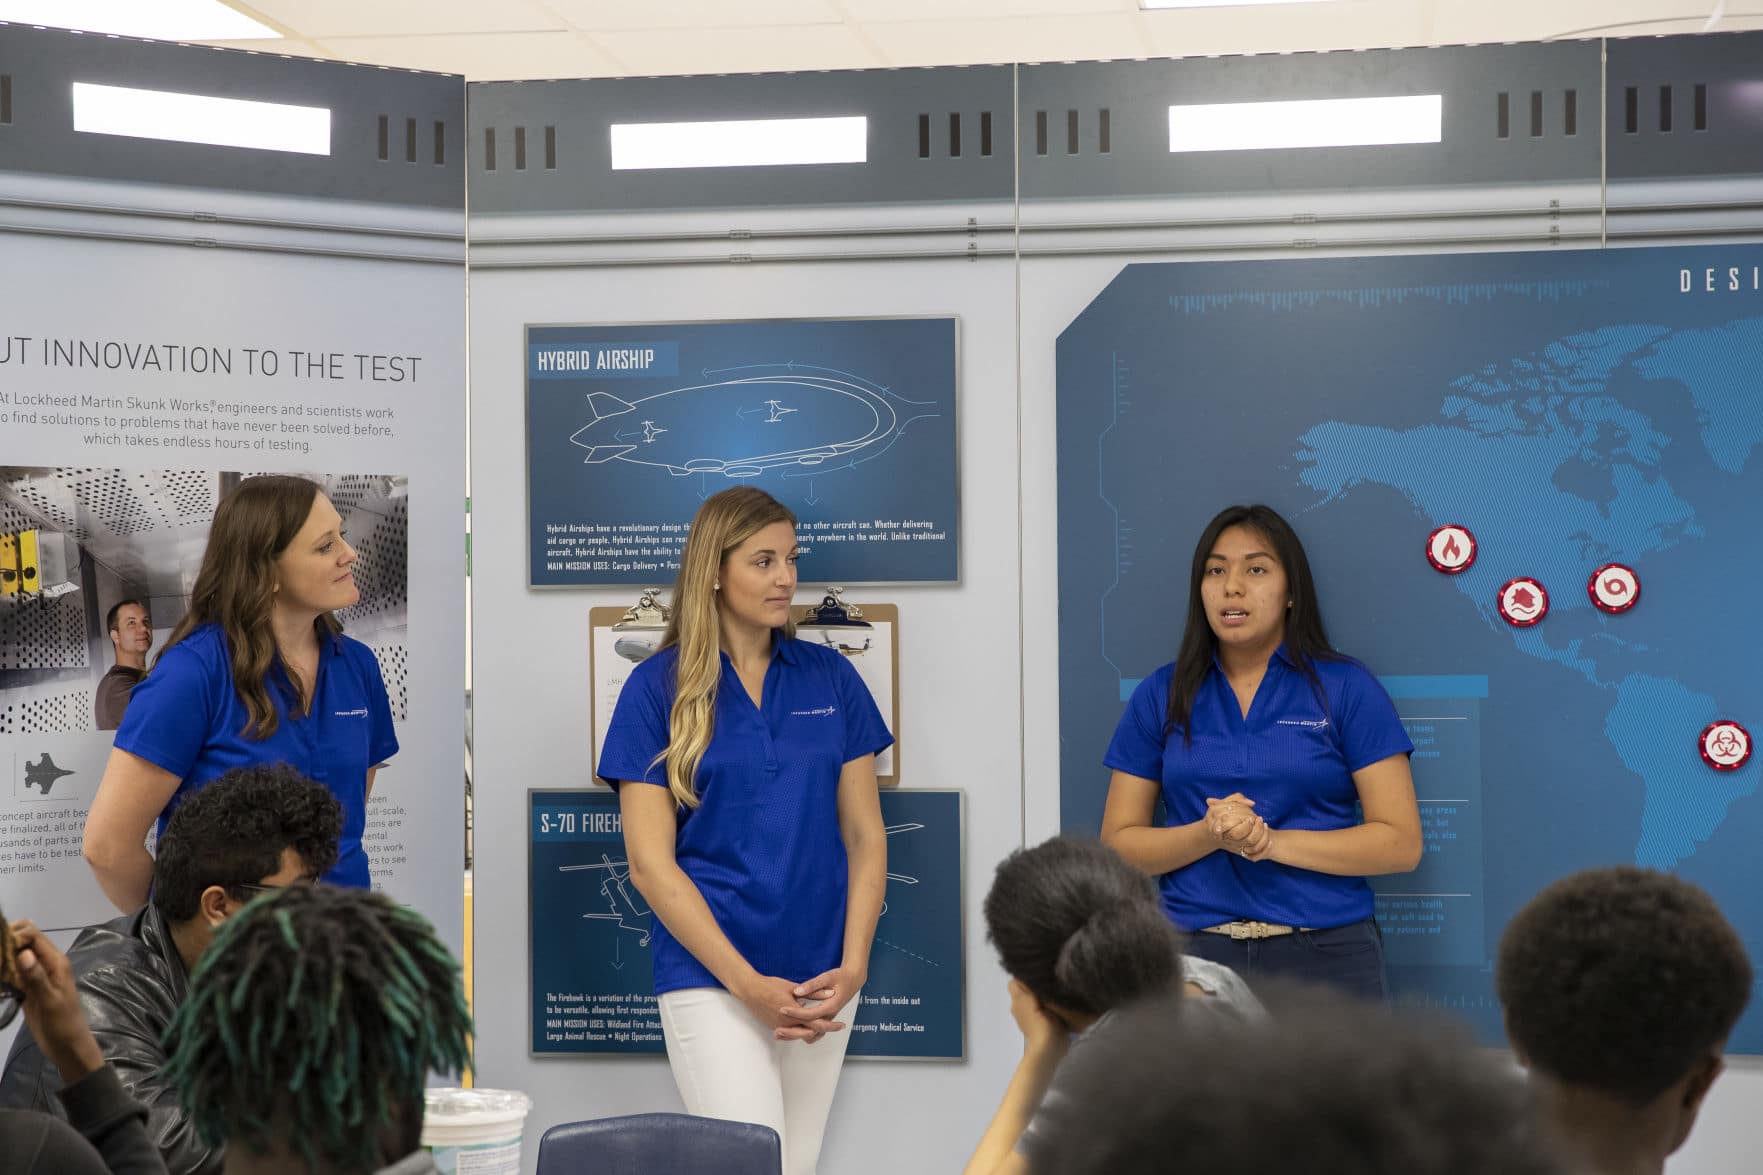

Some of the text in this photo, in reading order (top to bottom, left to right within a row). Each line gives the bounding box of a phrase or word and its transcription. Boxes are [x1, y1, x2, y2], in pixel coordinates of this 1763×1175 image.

[1680, 266, 1759, 292] DESI
[0, 337, 422, 382] UT INNOVATION TO THE TEST
[538, 349, 654, 371] HYBRID AIRSHIP
[14, 392, 77, 407] Lockheed
[81, 394, 123, 408] Martin
[127, 396, 166, 410] Skunk
[217, 402, 278, 416] engineers
[281, 404, 303, 416] and
[306, 405, 363, 418] scientists
[365, 408, 394, 418] work
[0, 410, 394, 437] o find solutions to problems that have never been solved before,
[83, 432, 313, 453] which takes endless hours of testing.
[546, 523, 567, 533] Hybrid
[569, 523, 594, 533] Airships
[596, 523, 610, 532] have
[619, 523, 659, 533] revolutionary
[661, 522, 681, 533] design
[814, 521, 829, 530] other
[832, 520, 857, 529] aircraft
[874, 519, 900, 529] Whether
[902, 519, 933, 530] delivering
[547, 536, 556, 545] aid
[559, 537, 576, 546] cargo
[612, 535, 633, 545] Hybrid
[635, 535, 660, 545] Airships
[817, 533, 846, 543] anywhere
[848, 532, 855, 541] in
[856, 532, 867, 541] the
[891, 532, 910, 540] Unlike
[912, 531, 946, 540] traditional
[575, 547, 596, 557] Hybrid
[597, 547, 622, 557] Airships
[624, 547, 639, 556] have
[641, 547, 651, 556] the
[653, 547, 672, 557] ability
[674, 547, 681, 555] to
[796, 546, 812, 554] ater.
[547, 560, 681, 571] MAIN MISSION USES: Cargo Delivery Pers
[36, 809, 70, 820] aircraft
[73, 808, 89, 818] bec
[54, 823, 65, 831] all
[68, 822, 77, 831] of
[388, 819, 402, 827] are
[541, 813, 622, 833] S-70 FIREH
[33, 837, 42, 846] of
[45, 836, 69, 847] parts
[71, 836, 83, 844] an
[383, 843, 404, 852] work
[15, 851, 36, 860] have
[39, 850, 47, 859] to
[50, 849, 62, 858] be
[64, 848, 83, 857] test
[381, 856, 390, 864] to
[391, 856, 407, 864] see
[18, 863, 47, 873] limits.
[546, 993, 557, 1002] The
[558, 993, 584, 1002] Firehawk
[598, 993, 624, 1002] variation
[625, 993, 631, 1002] of
[633, 993, 642, 1002] the
[865, 996, 879, 1004] from
[881, 996, 890, 1005] the
[892, 996, 909, 1005] inside
[910, 997, 920, 1005] out
[546, 1006, 553, 1014] to
[554, 1005, 562, 1014] be
[591, 1005, 615, 1015] allowing
[617, 1006, 629, 1014] first
[546, 1020, 562, 1028] MAIN
[564, 1020, 587, 1028] MISSION
[589, 1020, 606, 1028] USES:
[607, 1020, 631, 1028] Wildland
[633, 1020, 644, 1028] Fire
[879, 1023, 902, 1032] Medical
[903, 1023, 925, 1032] Service
[546, 1032, 662, 1042] Large Animal Rescue Night Operations
